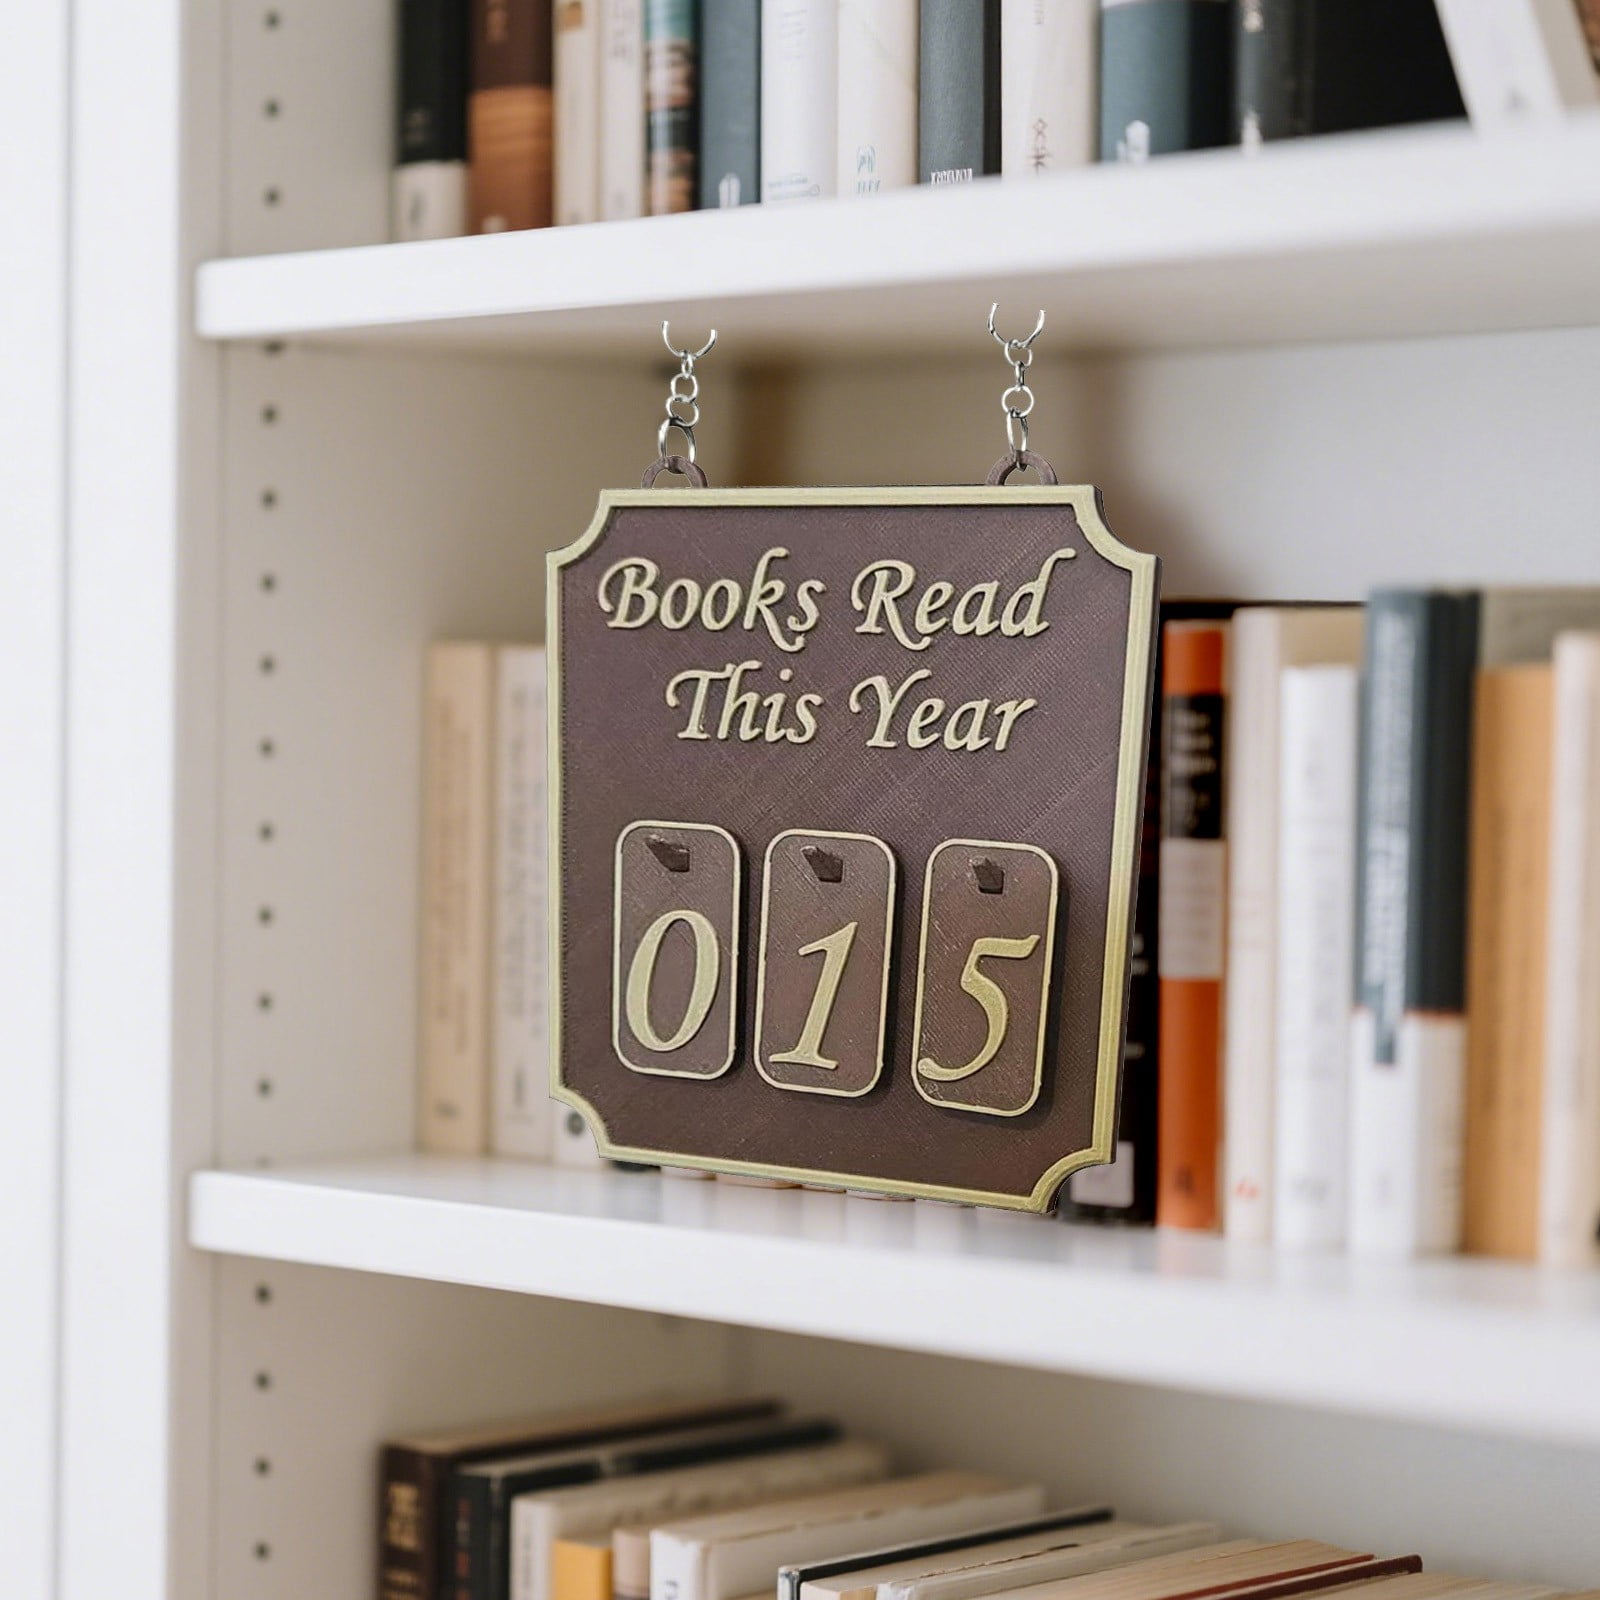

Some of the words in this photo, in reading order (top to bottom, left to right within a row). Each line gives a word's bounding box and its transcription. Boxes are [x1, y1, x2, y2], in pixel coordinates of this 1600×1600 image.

[598, 547, 826, 652] Books
[850, 547, 1076, 651] Read
[665, 659, 823, 744] This
[849, 668, 1037, 752] Year
